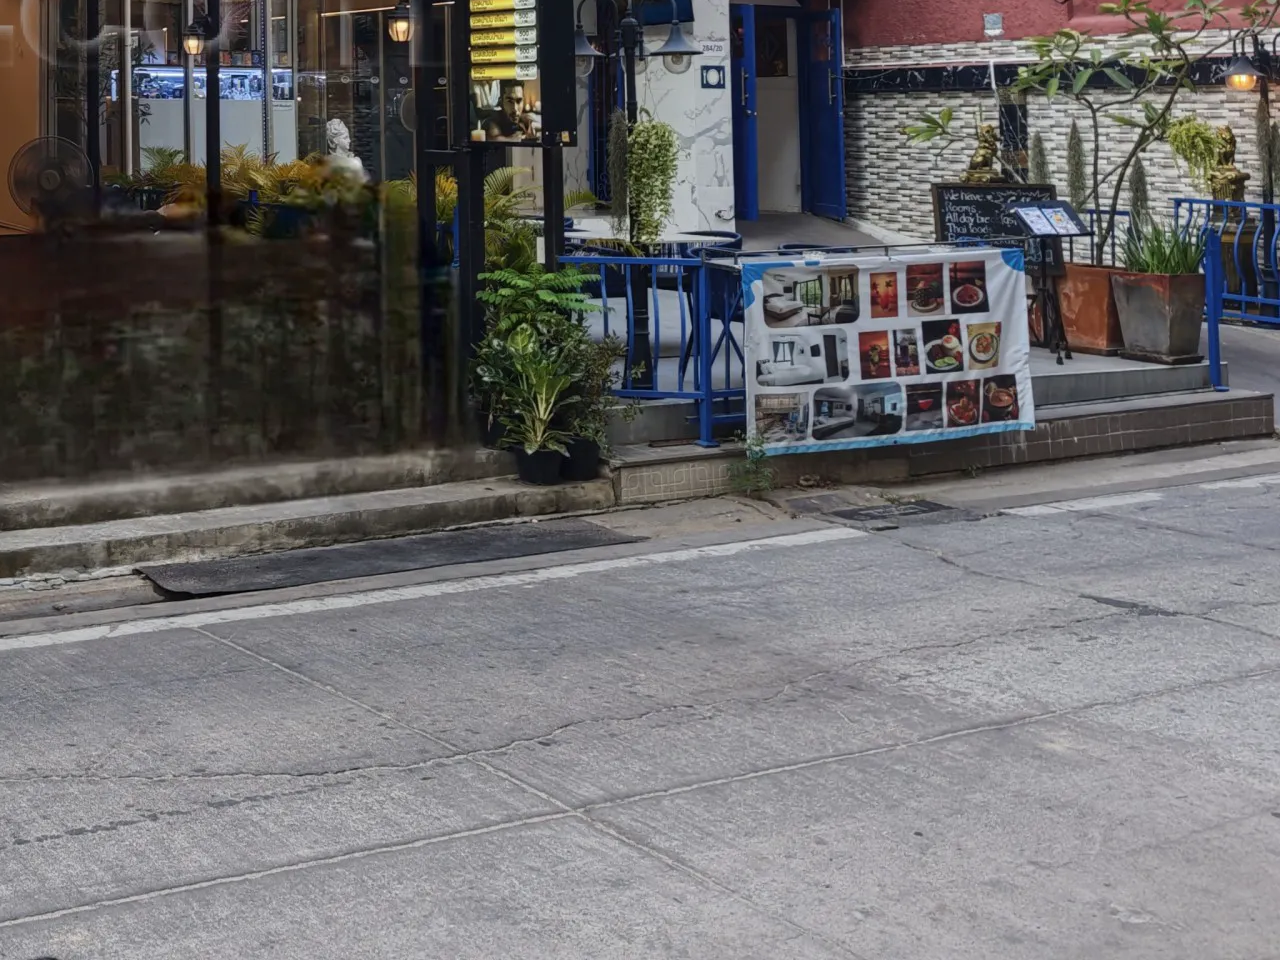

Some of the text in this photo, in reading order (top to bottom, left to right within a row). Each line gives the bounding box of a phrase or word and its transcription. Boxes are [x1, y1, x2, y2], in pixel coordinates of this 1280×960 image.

[943, 189, 960, 201] We
[945, 201, 977, 213] Rooms
[945, 212, 959, 223] All
[960, 213, 974, 226] day
[946, 223, 968, 233] Thai
